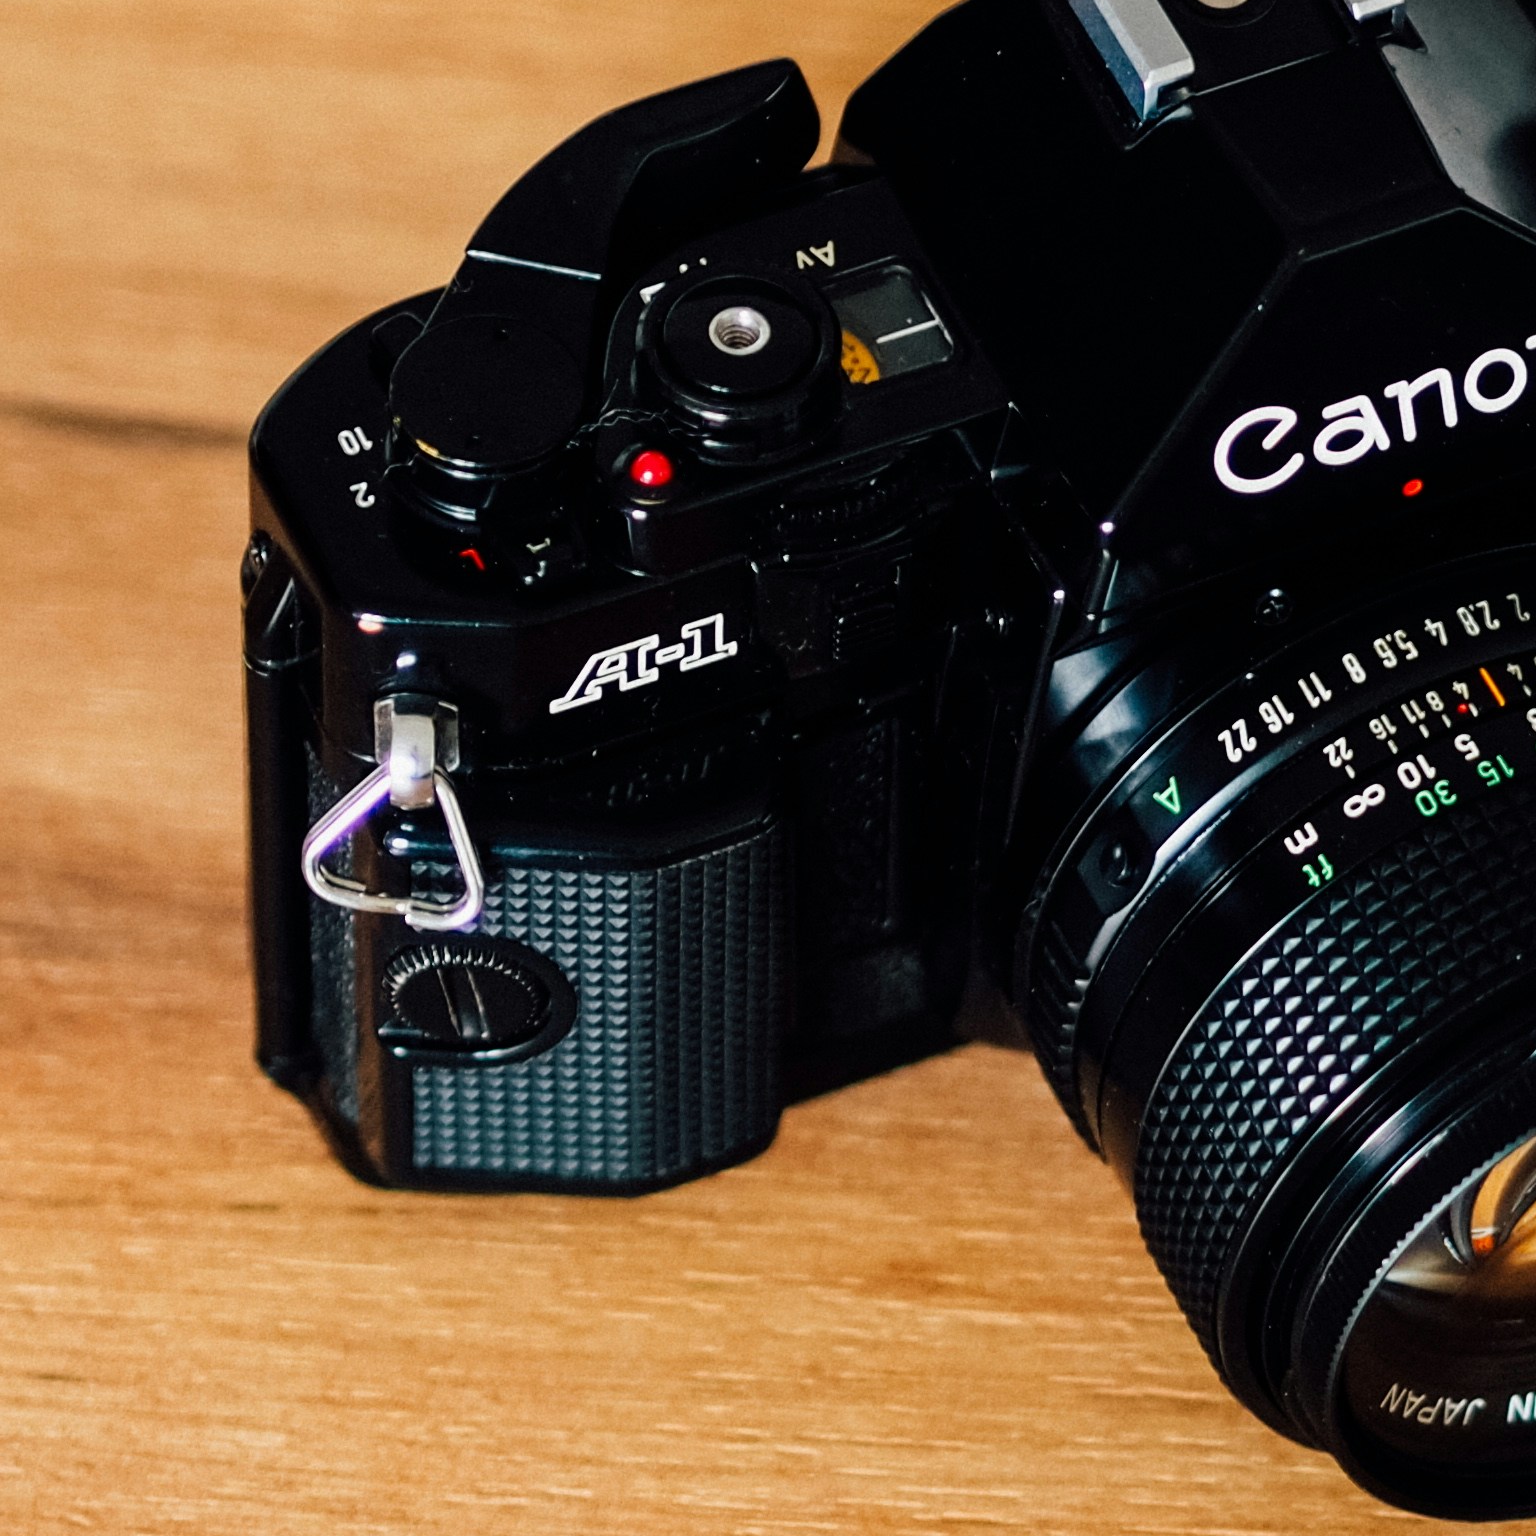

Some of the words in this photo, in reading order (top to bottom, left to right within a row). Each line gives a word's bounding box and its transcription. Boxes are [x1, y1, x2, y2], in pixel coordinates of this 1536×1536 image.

[796, 240, 835, 270] Av
[337, 426, 373, 456] 10
[349, 481, 376, 508] 2
[1456, 600, 1501, 636] 2.8
[1506, 593, 1531, 622] 2
[1373, 629, 1419, 669] 5.6
[1424, 618, 1448, 646] 4
[548, 612, 738, 715] A-1
[1341, 652, 1367, 684] 8
[1297, 671, 1332, 708] 11
[1258, 694, 1295, 734] 16
[1368, 714, 1397, 740] 16
[1217, 718, 1257, 763] 22
[1322, 736, 1354, 769] 22
[1454, 733, 1480, 761] 5
[1396, 754, 1439, 792] 10
[1474, 752, 1514, 787] 15
[1152, 775, 1181, 815] A
[1413, 777, 1457, 817] 30
[1283, 821, 1319, 855] m
[1301, 853, 1334, 887] ft
[1381, 1383, 1486, 1426] JAPAN
